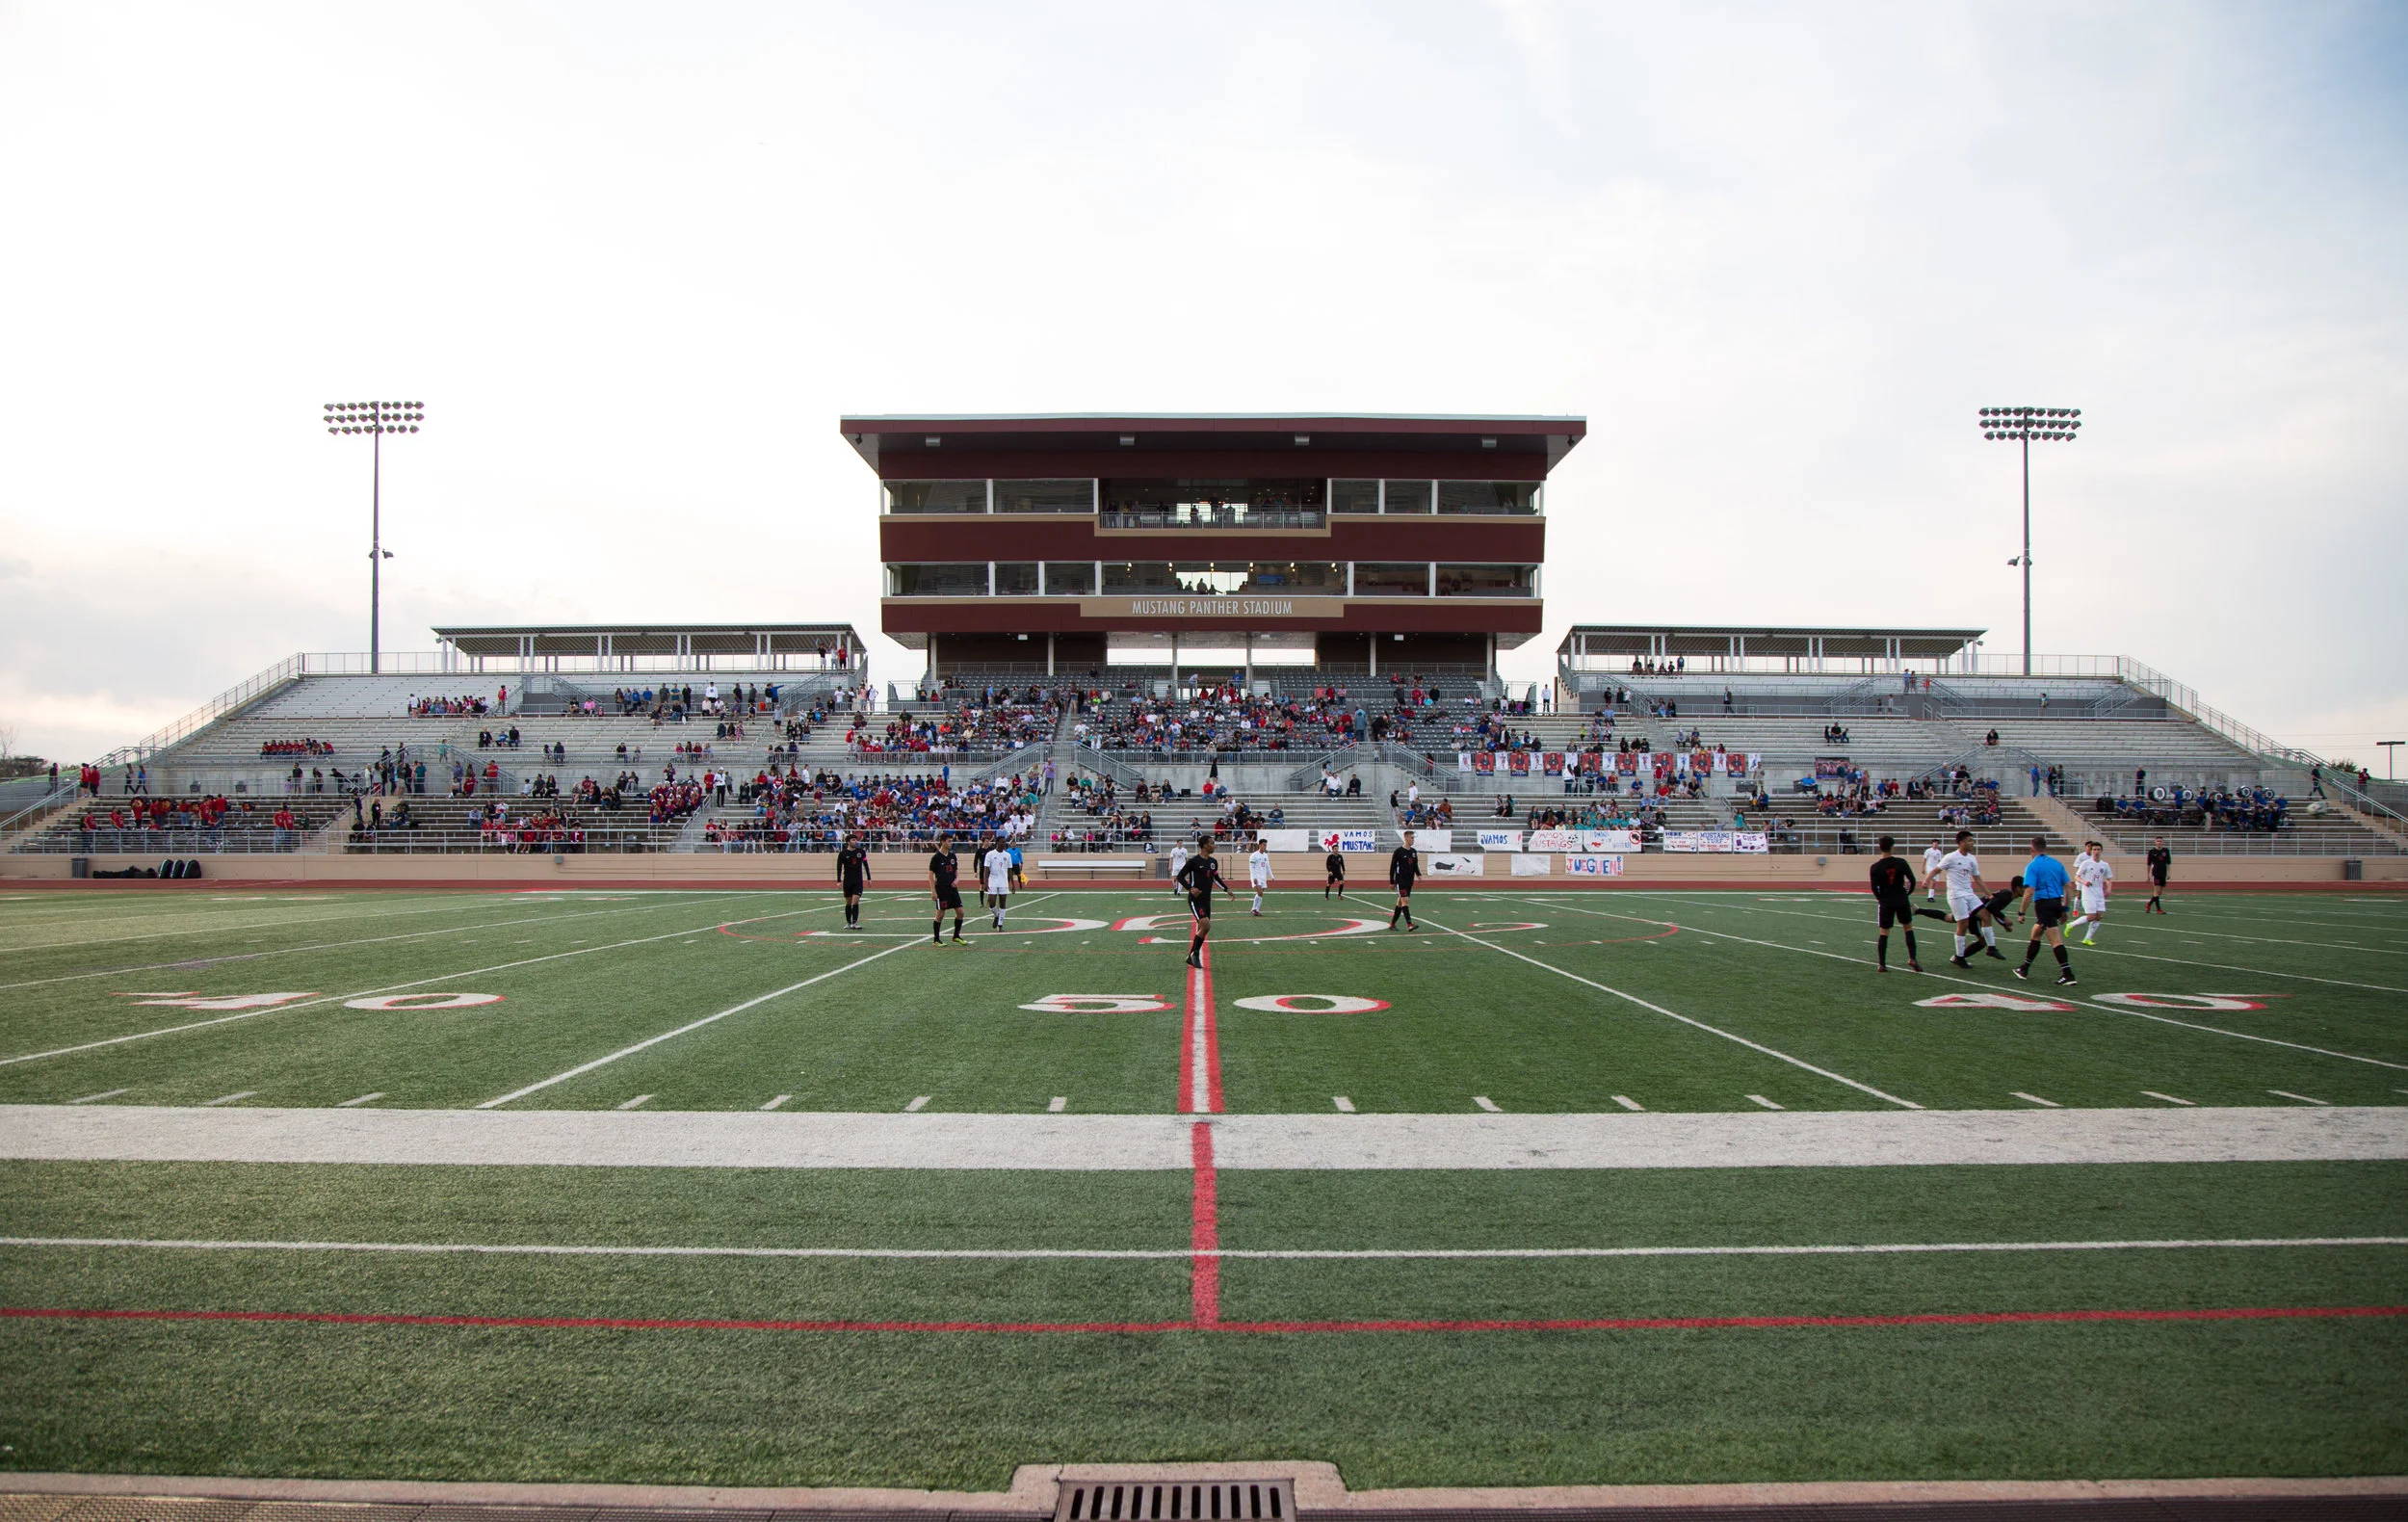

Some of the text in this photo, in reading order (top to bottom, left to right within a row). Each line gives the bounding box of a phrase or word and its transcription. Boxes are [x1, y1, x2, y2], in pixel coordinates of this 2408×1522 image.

[1132, 600, 1293, 615] MUSTANG PANTHER STADIUM
[1566, 857, 1617, 875] JUEGUEN
